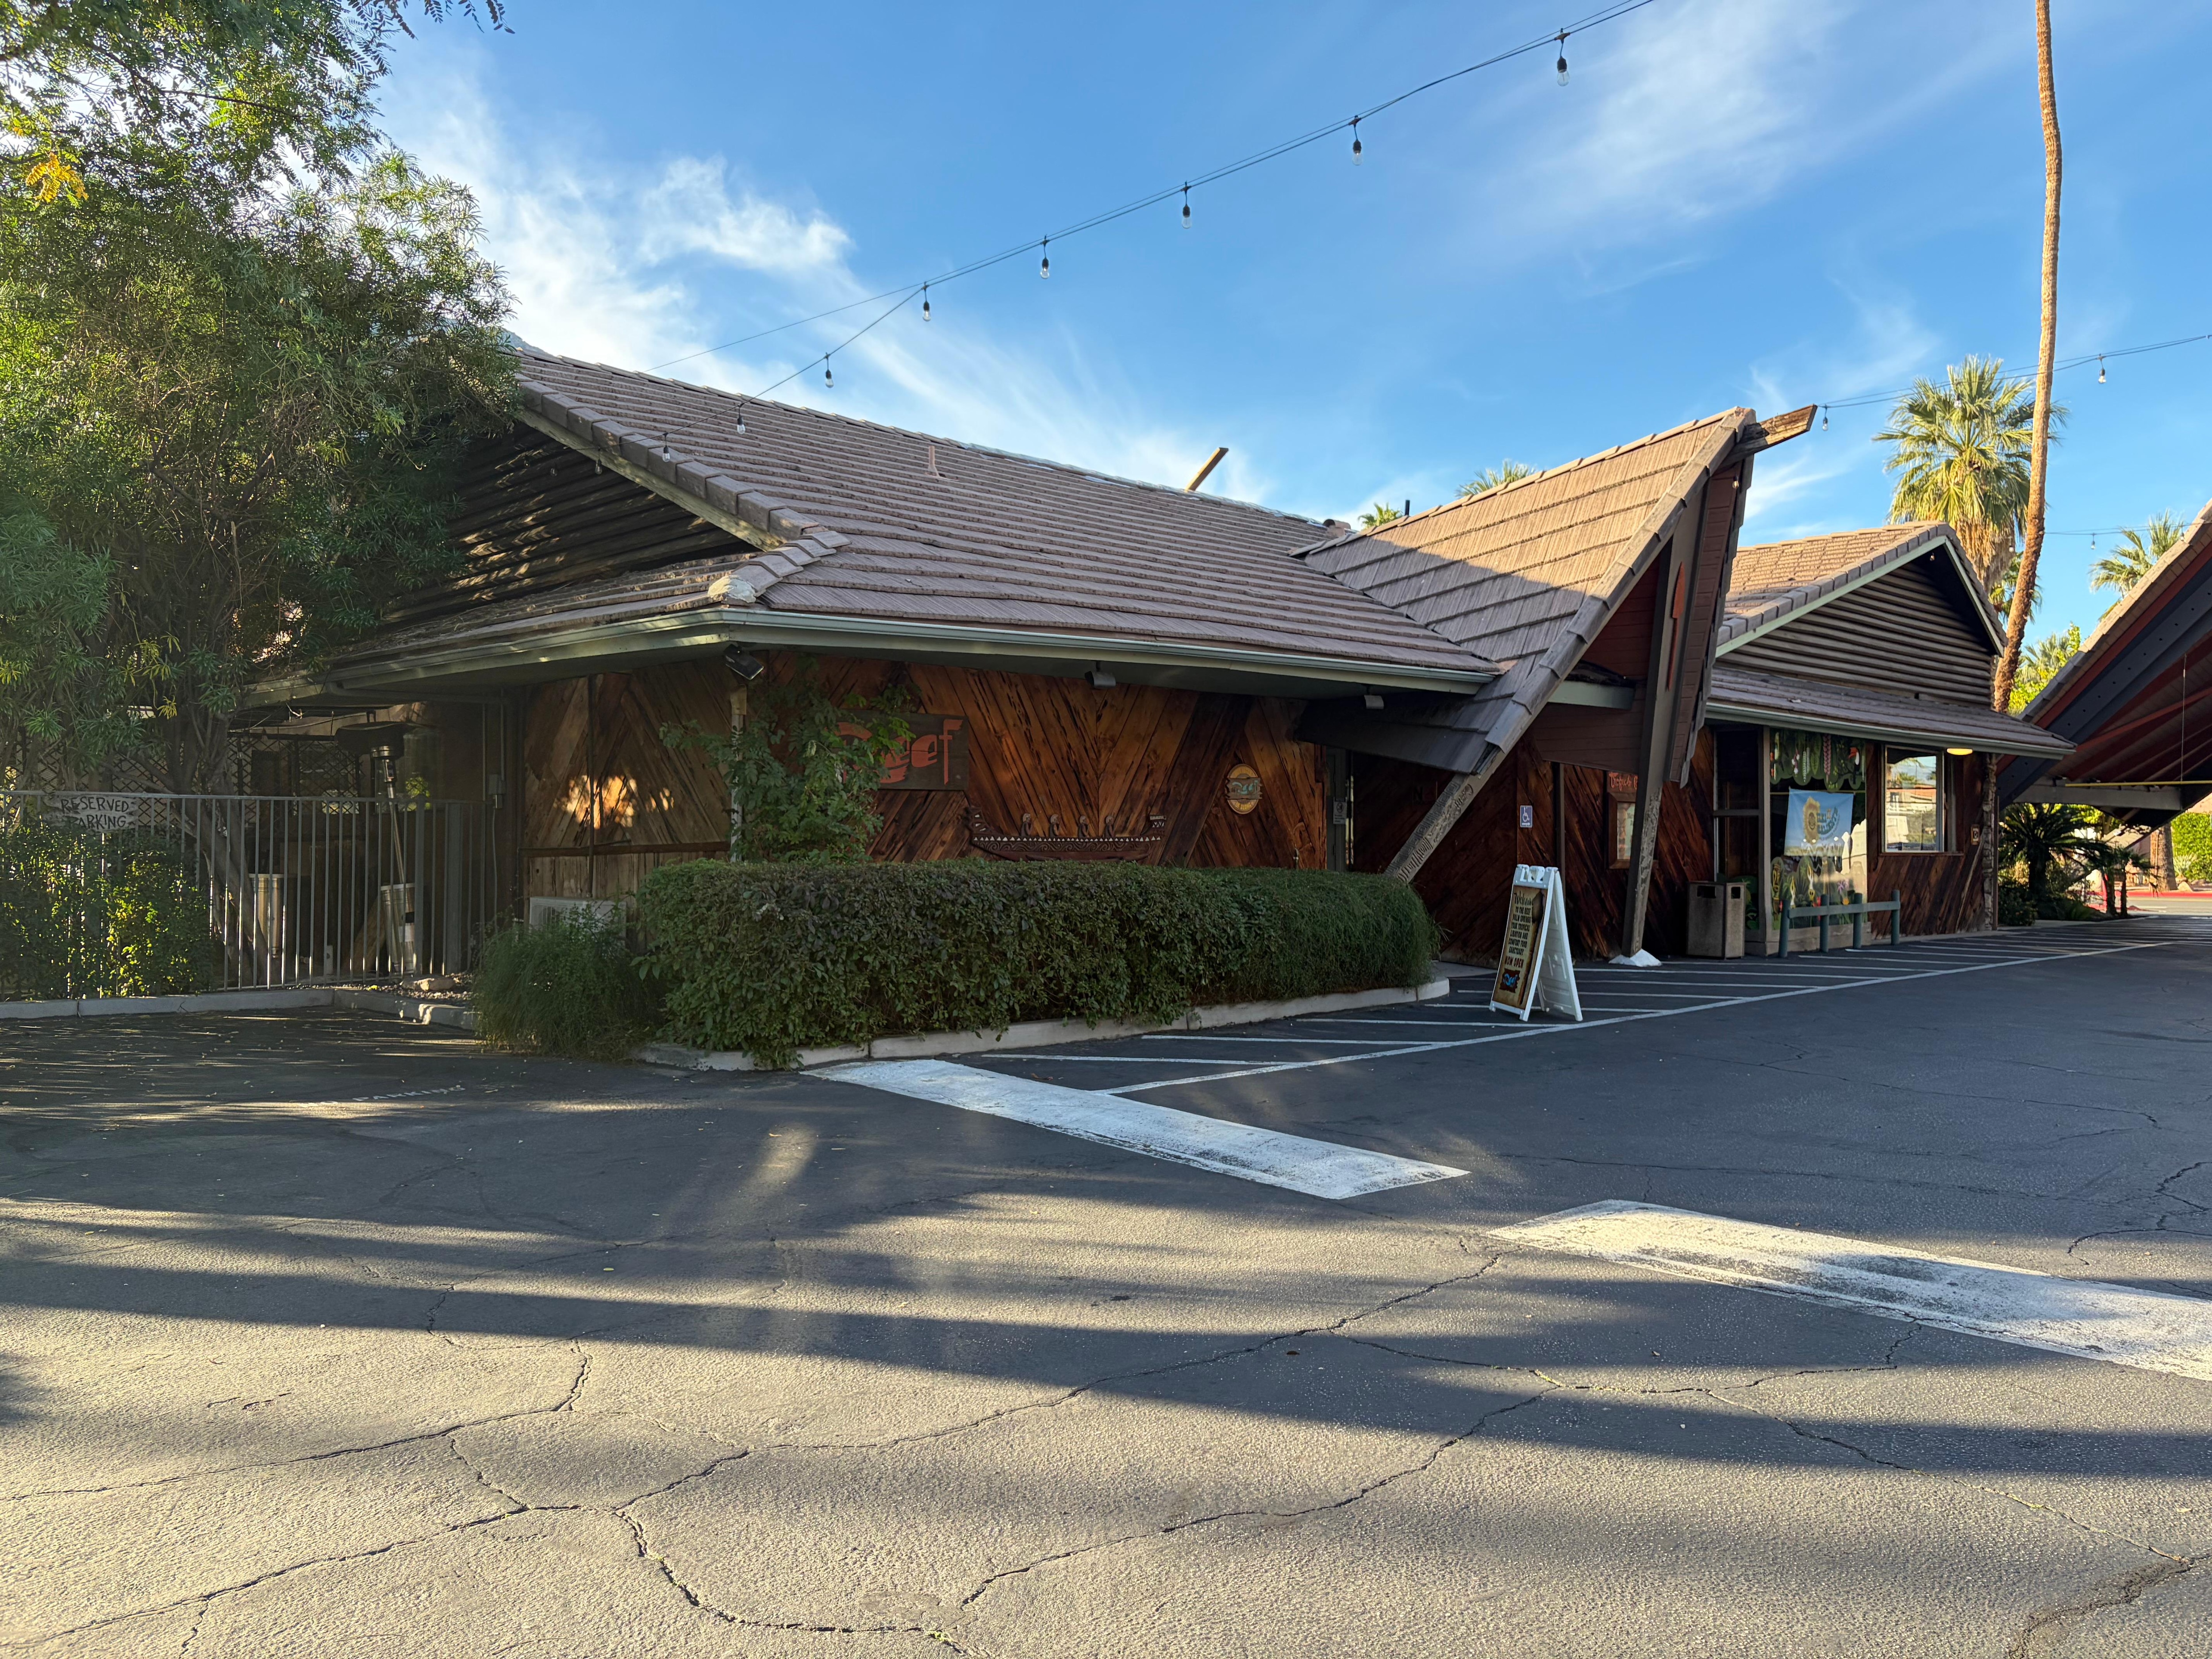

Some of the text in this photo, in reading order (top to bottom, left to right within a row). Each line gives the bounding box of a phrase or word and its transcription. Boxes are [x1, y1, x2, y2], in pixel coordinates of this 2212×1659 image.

[61, 796, 129, 814] RESERVED
[1518, 923, 1530, 931] TROPICAL
[1505, 956, 1524, 968] NOW OPEN
